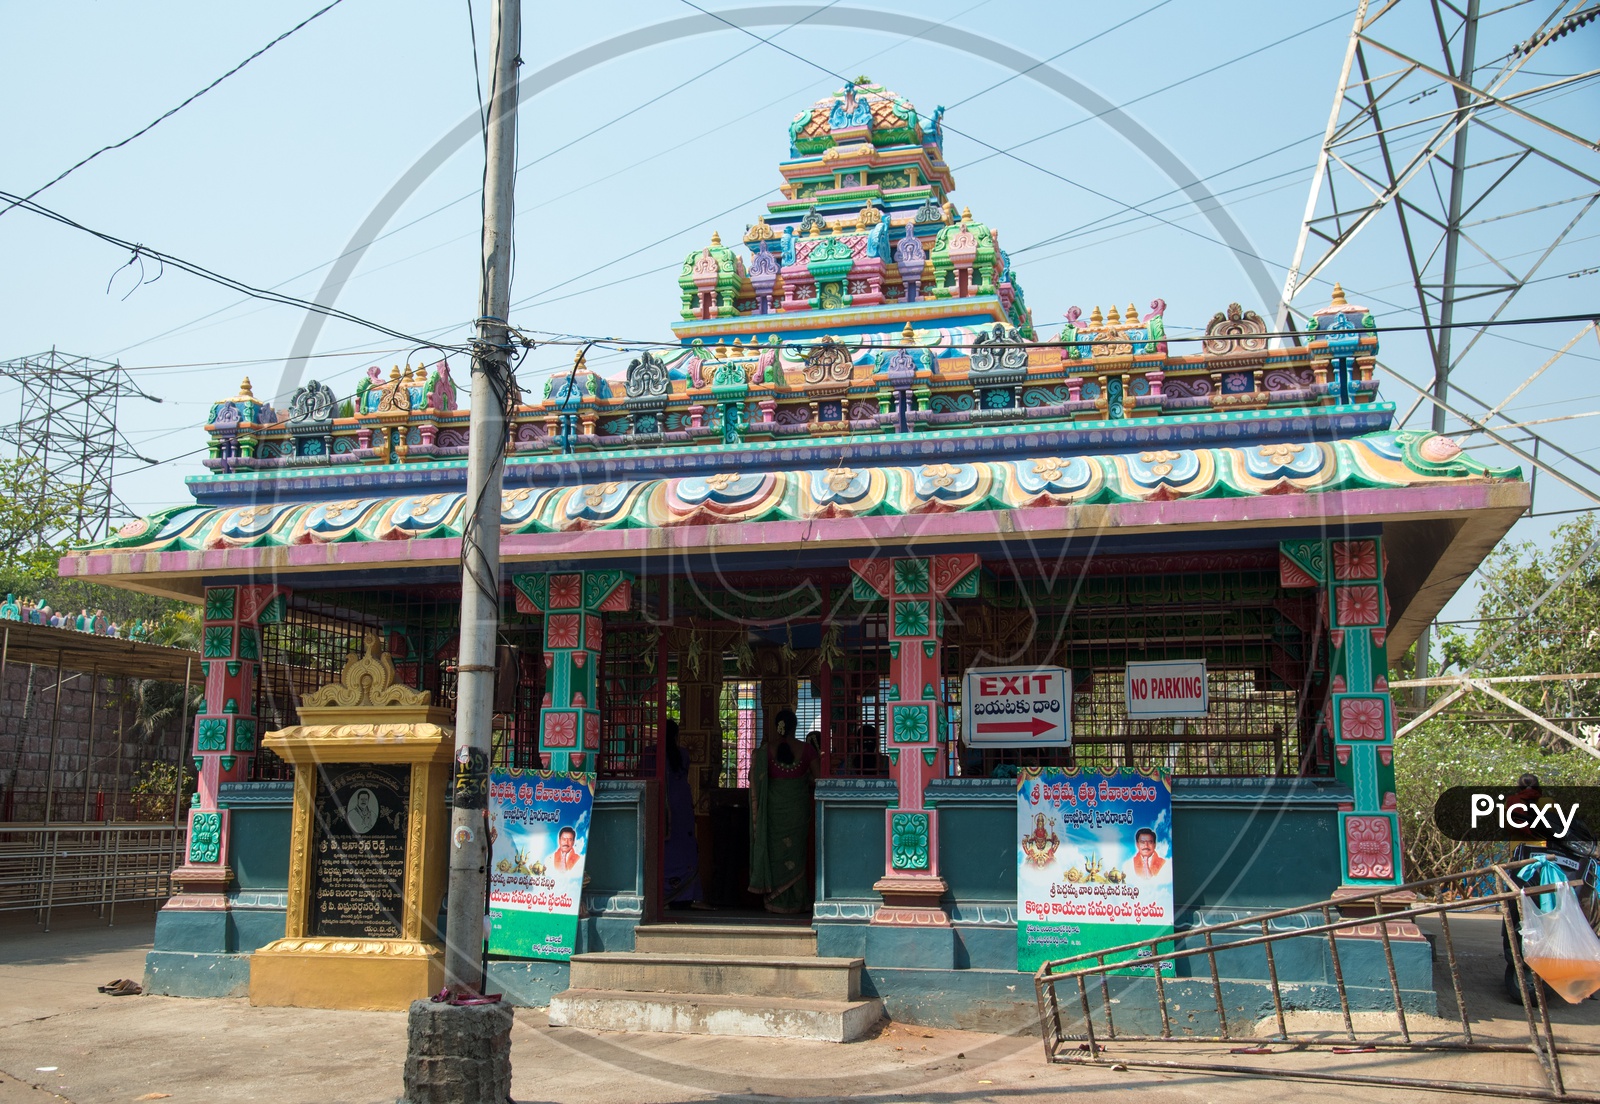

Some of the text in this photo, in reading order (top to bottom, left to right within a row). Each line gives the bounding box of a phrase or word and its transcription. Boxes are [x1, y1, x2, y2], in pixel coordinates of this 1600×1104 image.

[980, 674, 1052, 696] EXIT
[1131, 676, 1202, 700] NO PARKING
[974, 698, 1061, 715] బయటకు దారి
[1030, 780, 1157, 807] శ్రీ పెద్దమ్మ తల్లి దేవాలయం
[1025, 900, 1050, 920] కొబ్బరి
[1051, 900, 1086, 916] కాయలు
[1087, 900, 1132, 922] సమర్పించు
